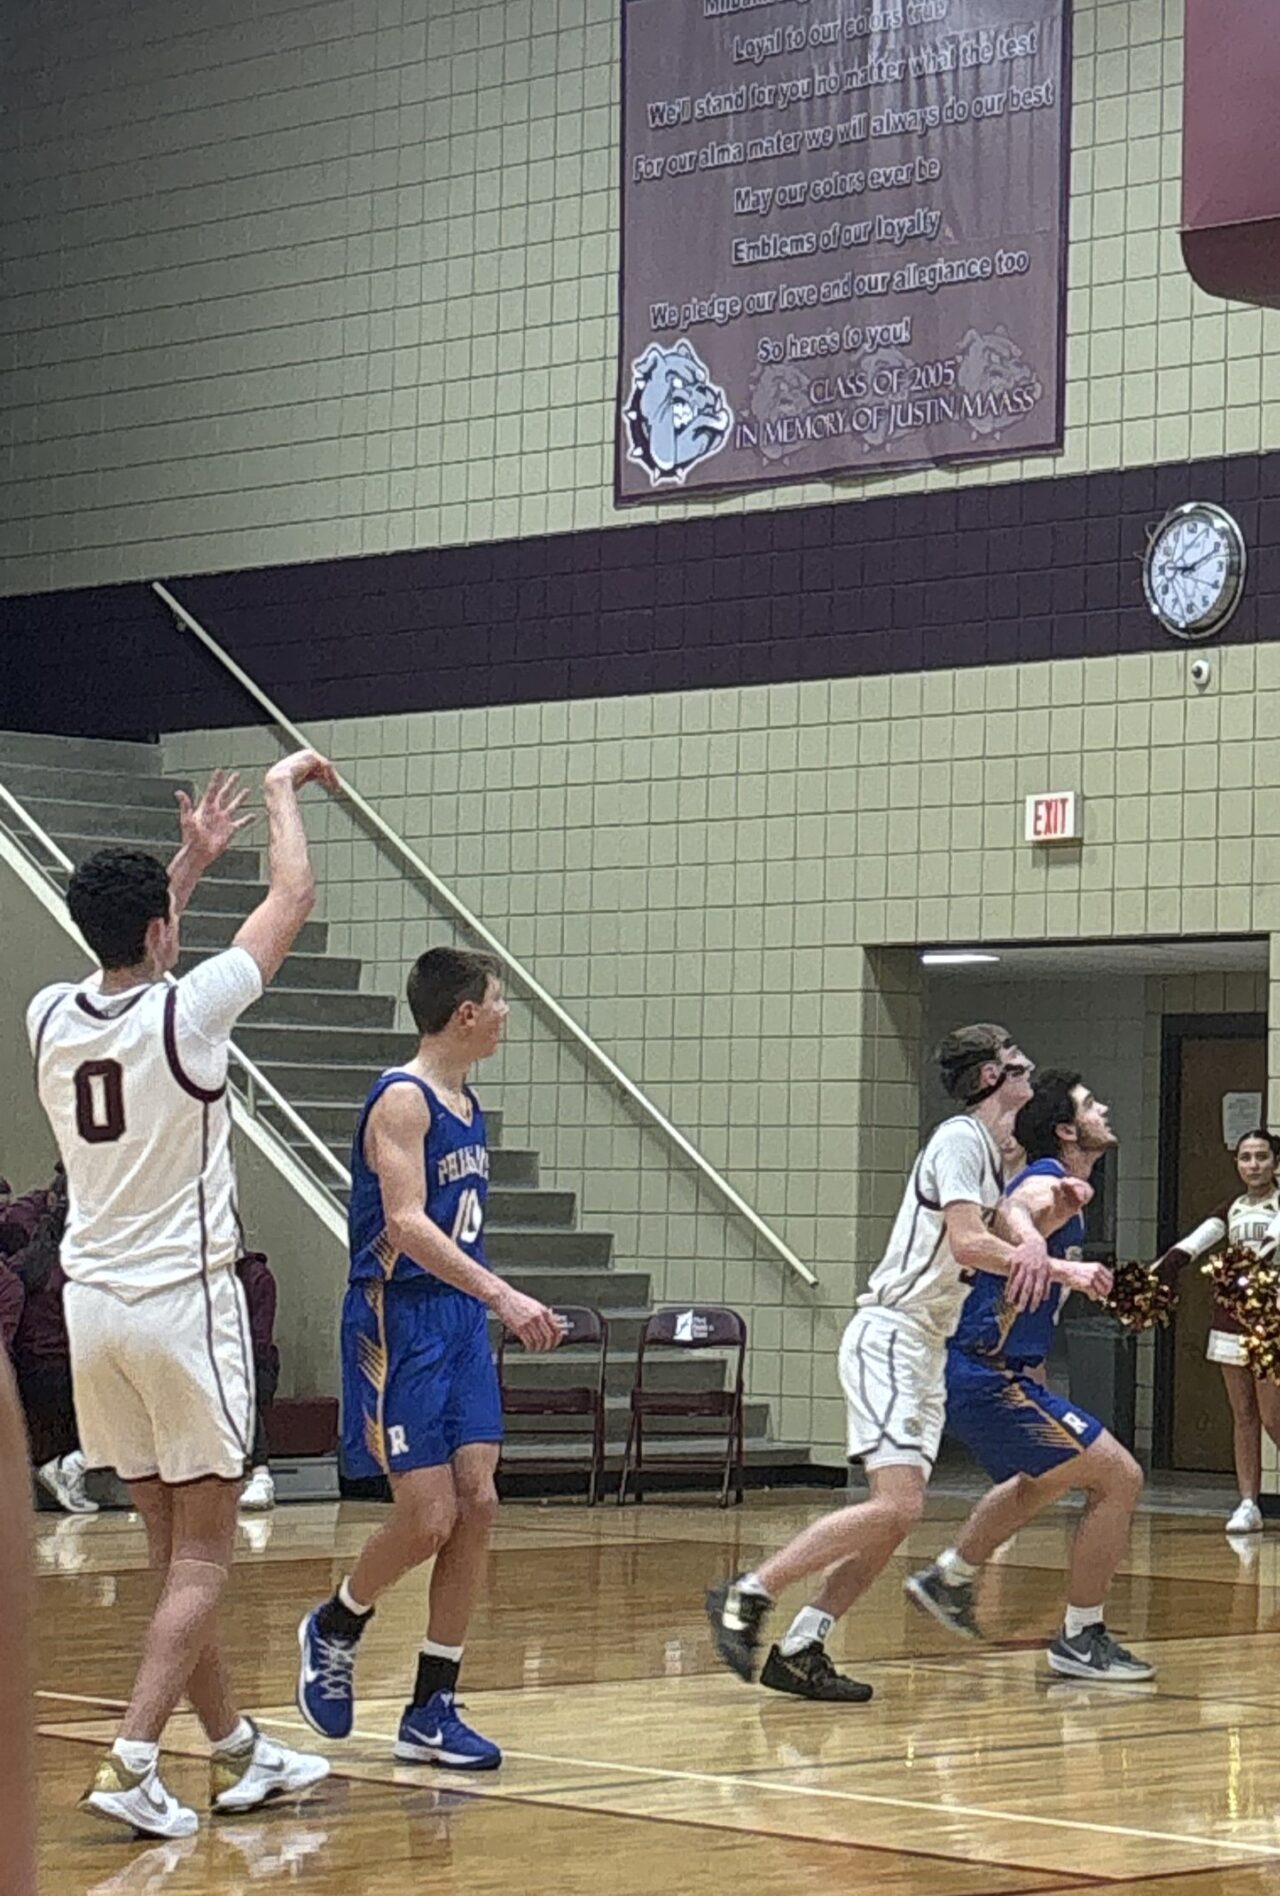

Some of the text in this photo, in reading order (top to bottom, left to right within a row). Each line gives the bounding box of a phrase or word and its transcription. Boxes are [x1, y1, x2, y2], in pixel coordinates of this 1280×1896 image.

[734, 33, 783, 64] Loyal
[786, 28, 806, 51] to
[808, 20, 840, 46] our
[843, 8, 902, 40] colors
[694, 86, 746, 120] stand
[749, 81, 778, 110] for
[779, 76, 811, 111] you
[815, 69, 839, 97] no
[842, 57, 907, 92] matter
[908, 44, 957, 77] what
[959, 37, 993, 67] the
[995, 29, 1038, 61] test
[633, 78, 1056, 183] For our alma mater we will always do our best
[734, 155, 941, 217] May our colors ever be
[733, 207, 942, 265] Emblems of our loyalty
[651, 249, 1030, 331] We pledge our love and our allegiance too
[757, 334, 783, 364] So
[843, 324, 864, 352] to
[866, 316, 912, 354] you!
[809, 359, 957, 406] CLASS OF 2005
[734, 385, 1036, 450] IN MEMORY OF JUSTIN MAASS
[1032, 797, 1070, 837] EXIT
[72, 1057, 127, 1145] 0
[386, 1423, 411, 1456] R
